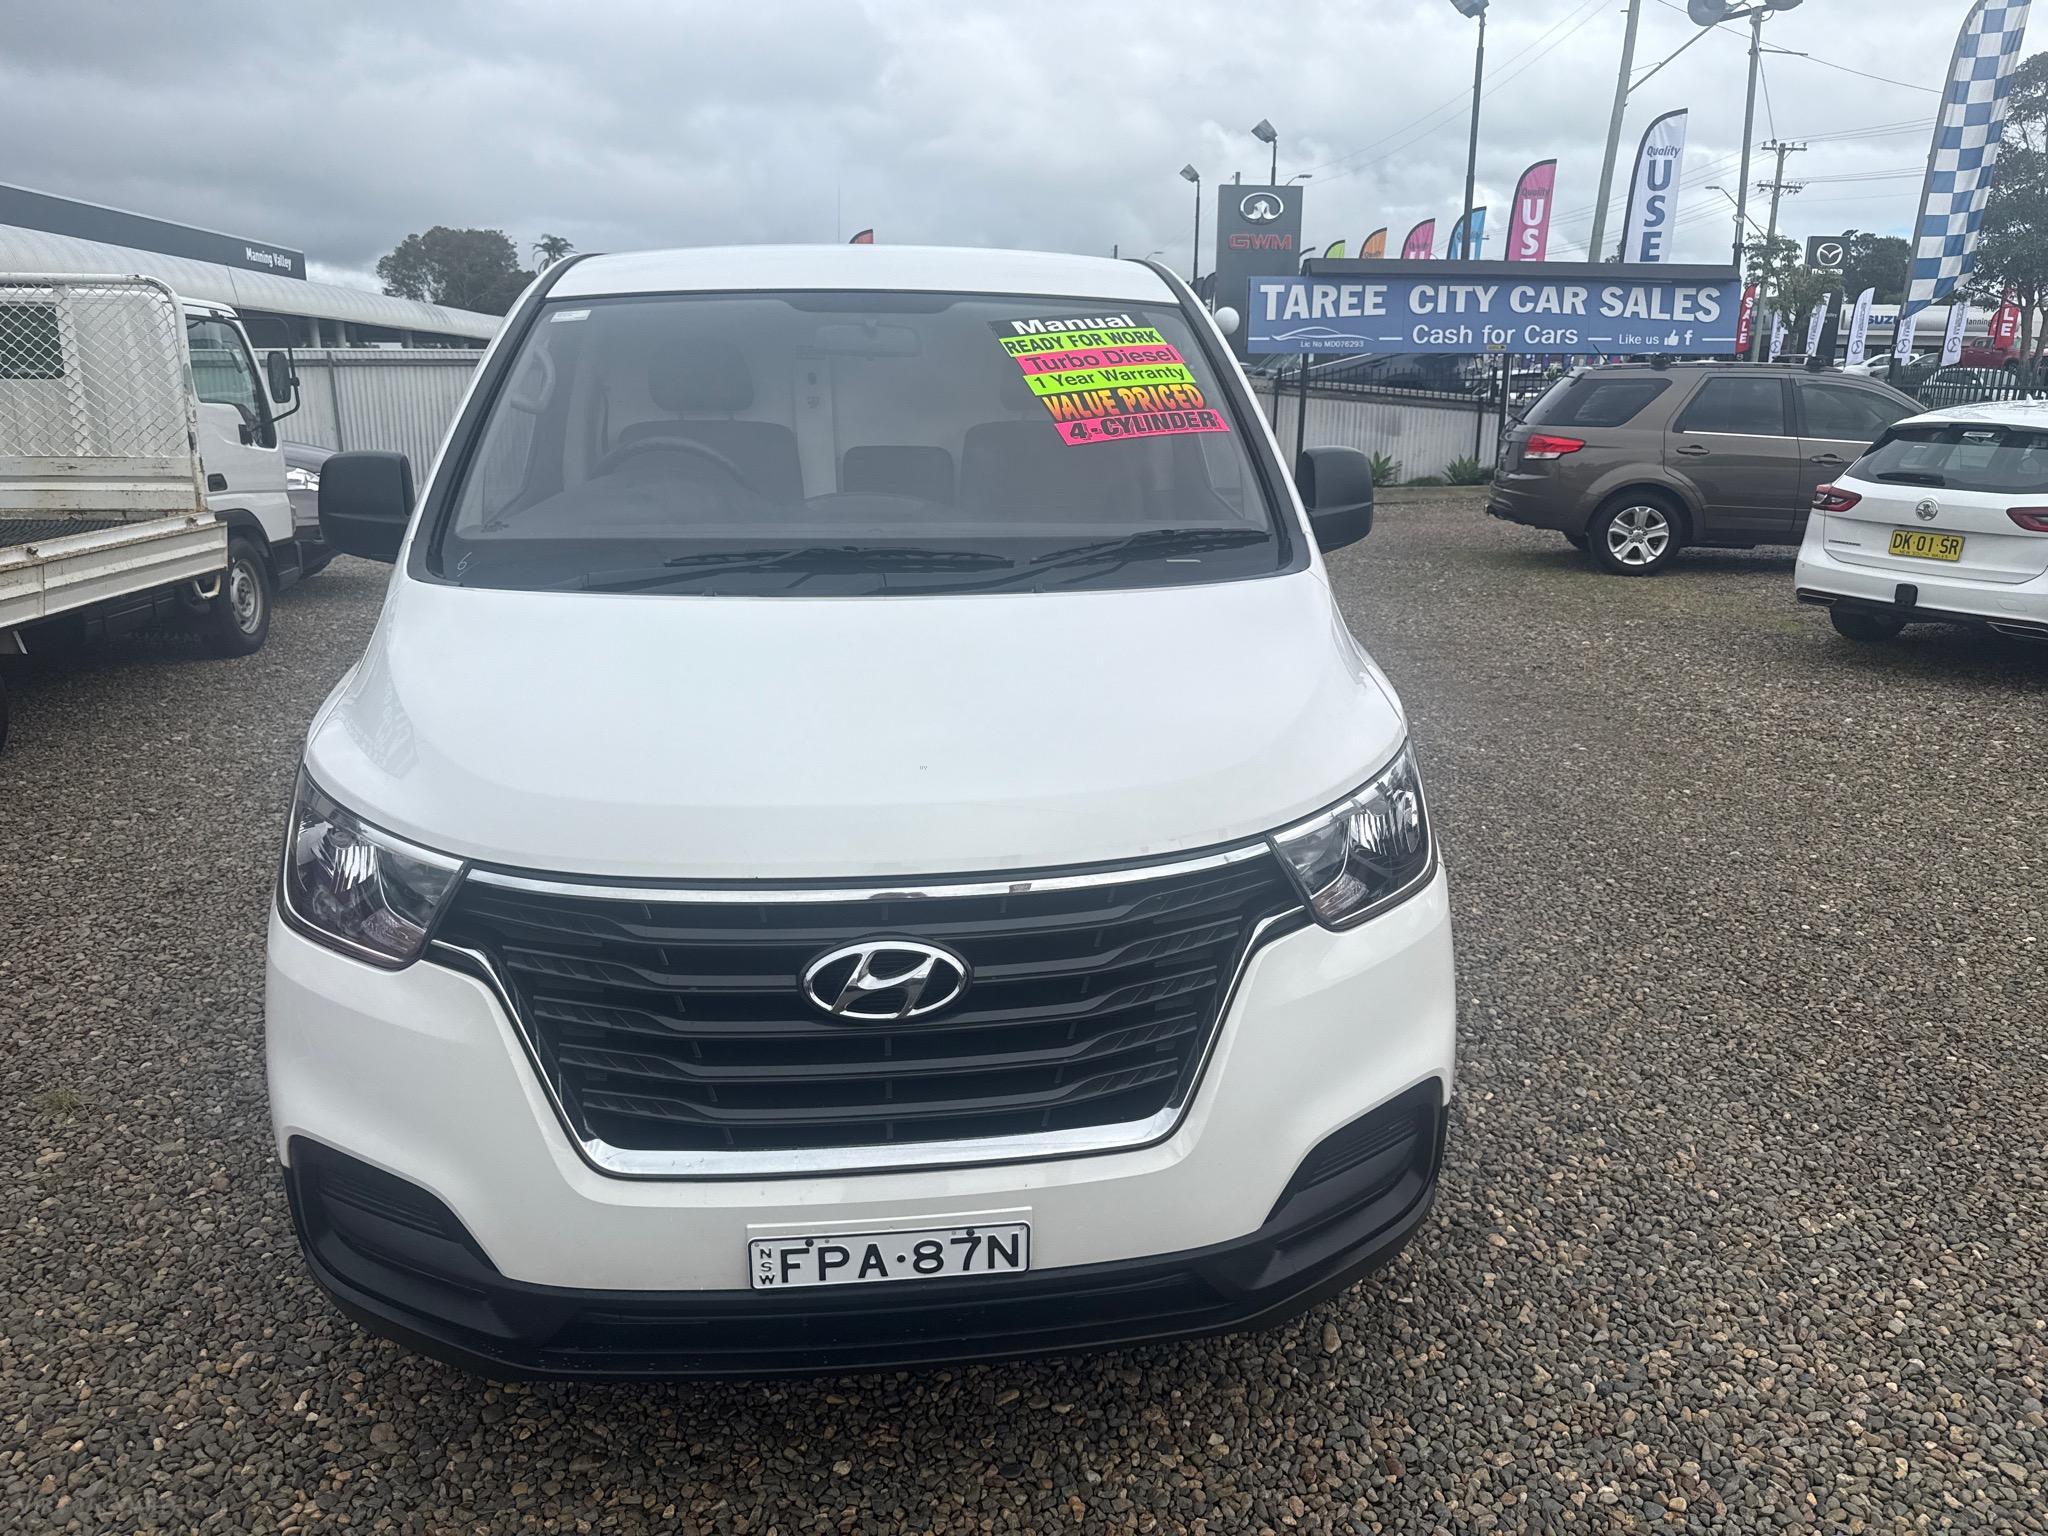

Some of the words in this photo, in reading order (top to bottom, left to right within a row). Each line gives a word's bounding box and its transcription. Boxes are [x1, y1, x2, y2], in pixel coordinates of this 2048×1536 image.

[1647, 145, 1681, 158] Quality
[1229, 234, 1292, 250] GWM
[246, 247, 273, 268] Manning
[272, 252, 292, 271] Valley
[1260, 284, 1387, 320] TAREE
[1409, 285, 1498, 315] CITY
[1510, 285, 1588, 315] CAR
[1600, 286, 1721, 323] SALES
[1011, 314, 1136, 336] Manual
[1739, 297, 1754, 344] SALE
[1004, 335, 1062, 354] READY
[1069, 333, 1107, 348] FOR
[1111, 330, 1162, 345] WORK
[1412, 324, 1473, 345] Cash
[1482, 324, 1516, 345] for
[1524, 324, 1578, 345] Cars
[1619, 333, 1642, 345] Like
[1646, 335, 1659, 345] us
[1025, 353, 1100, 372] Turbo
[1106, 349, 1178, 364] Diesel
[1034, 376, 1046, 389] 1
[1050, 372, 1094, 387] Year
[1104, 367, 1185, 384] Warranty
[1042, 389, 1121, 422] VALUE
[1117, 383, 1205, 414] PRICED
[1069, 411, 1219, 440] 4-CYLINDER
[759, 1248, 776, 1286] NSW
